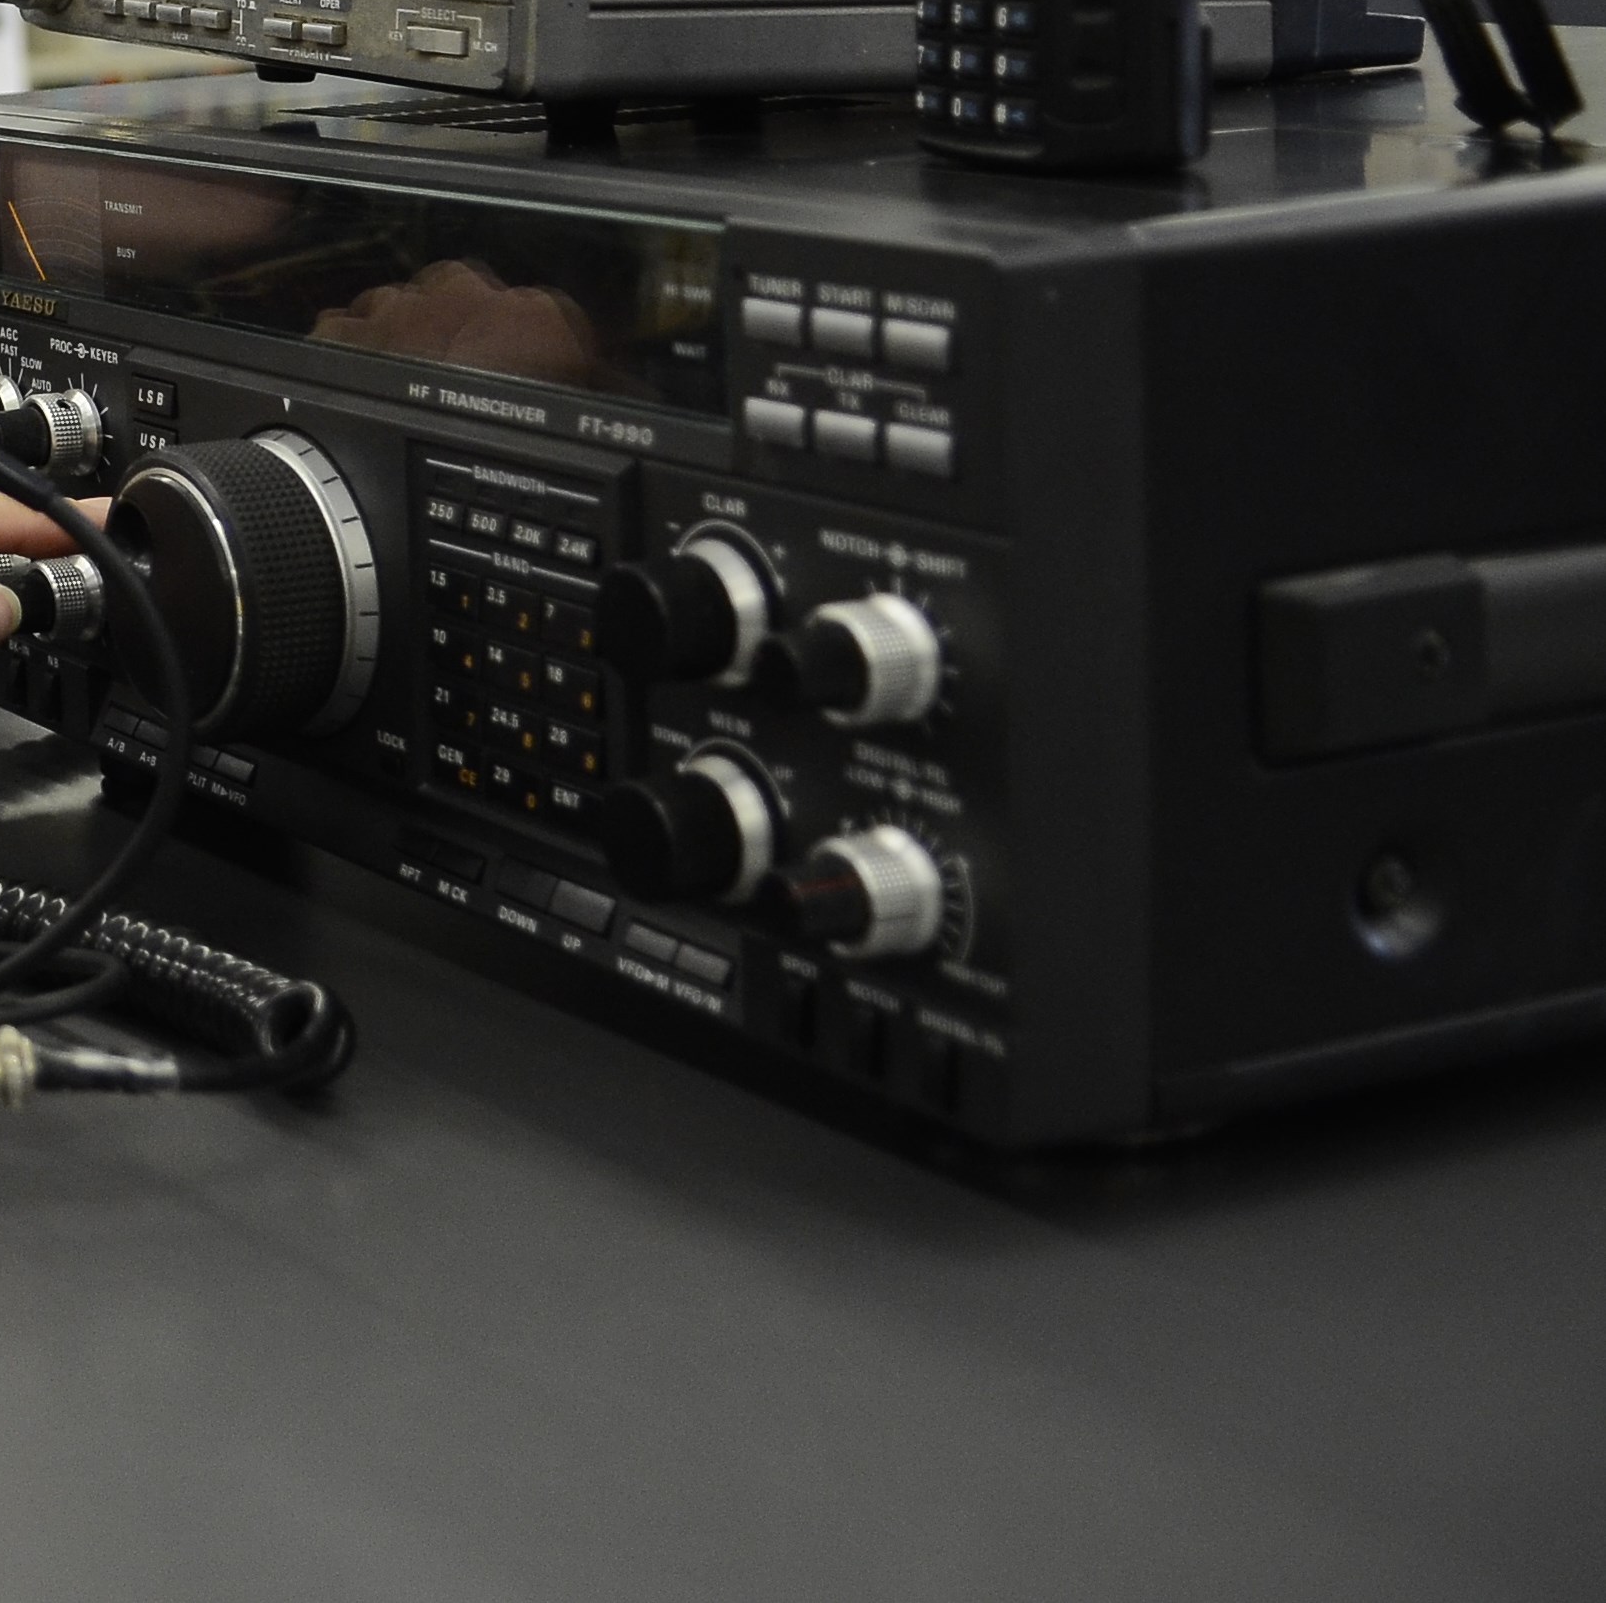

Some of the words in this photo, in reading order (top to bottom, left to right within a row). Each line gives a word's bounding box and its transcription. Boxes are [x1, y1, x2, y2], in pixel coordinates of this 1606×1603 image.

[236, 0, 247, 9] TO
[953, 4, 962, 24] 5
[420, 7, 457, 22] SELECT
[998, 7, 1007, 27] 6
[917, 45, 925, 65] 7
[953, 50, 961, 70] 8
[997, 56, 1006, 75] 9
[953, 97, 962, 117] 0
[104, 200, 143, 215] TRANSMIT
[116, 246, 136, 259] BUSY
[749, 274, 802, 296] TUNER
[0, 291, 57, 317] YAESU
[820, 283, 873, 307] START
[0, 326, 19, 341] AGC
[0, 343, 19, 357] FAST
[50, 338, 73, 355] PROC
[90, 347, 119, 364] KEYER
[20, 356, 43, 370] SLOW
[31, 377, 52, 392] AUTO
[826, 367, 874, 389] CLAR
[138, 388, 164, 406] LSB
[408, 383, 430, 399] HF
[439, 389, 546, 424] TRANSCEIVER
[578, 414, 654, 446] FT-990
[897, 402, 950, 425] CLEAR
[472, 464, 546, 494] BANDWIDTH
[429, 501, 454, 521] 250
[471, 512, 498, 532] 500
[493, 551, 530, 574] BAND
[430, 570, 447, 587] 1.5
[487, 586, 506, 605] 3.5
[545, 602, 556, 619] 7
[433, 628, 447, 644] 10
[47, 654, 59, 669] NB
[489, 646, 503, 663] 14
[547, 664, 564, 683] 18
[434, 686, 450, 704] 21
[107, 737, 125, 753] A/B
[376, 729, 406, 751] LOCK
[549, 726, 569, 745] 28
[139, 751, 158, 767] A=B
[438, 744, 464, 766] GEN
[189, 771, 207, 790] PLIT
[458, 768, 477, 786] CE
[493, 765, 511, 784] 29
[400, 863, 422, 882] RPT
[498, 905, 537, 934] DOWN
[562, 933, 582, 951] UP
